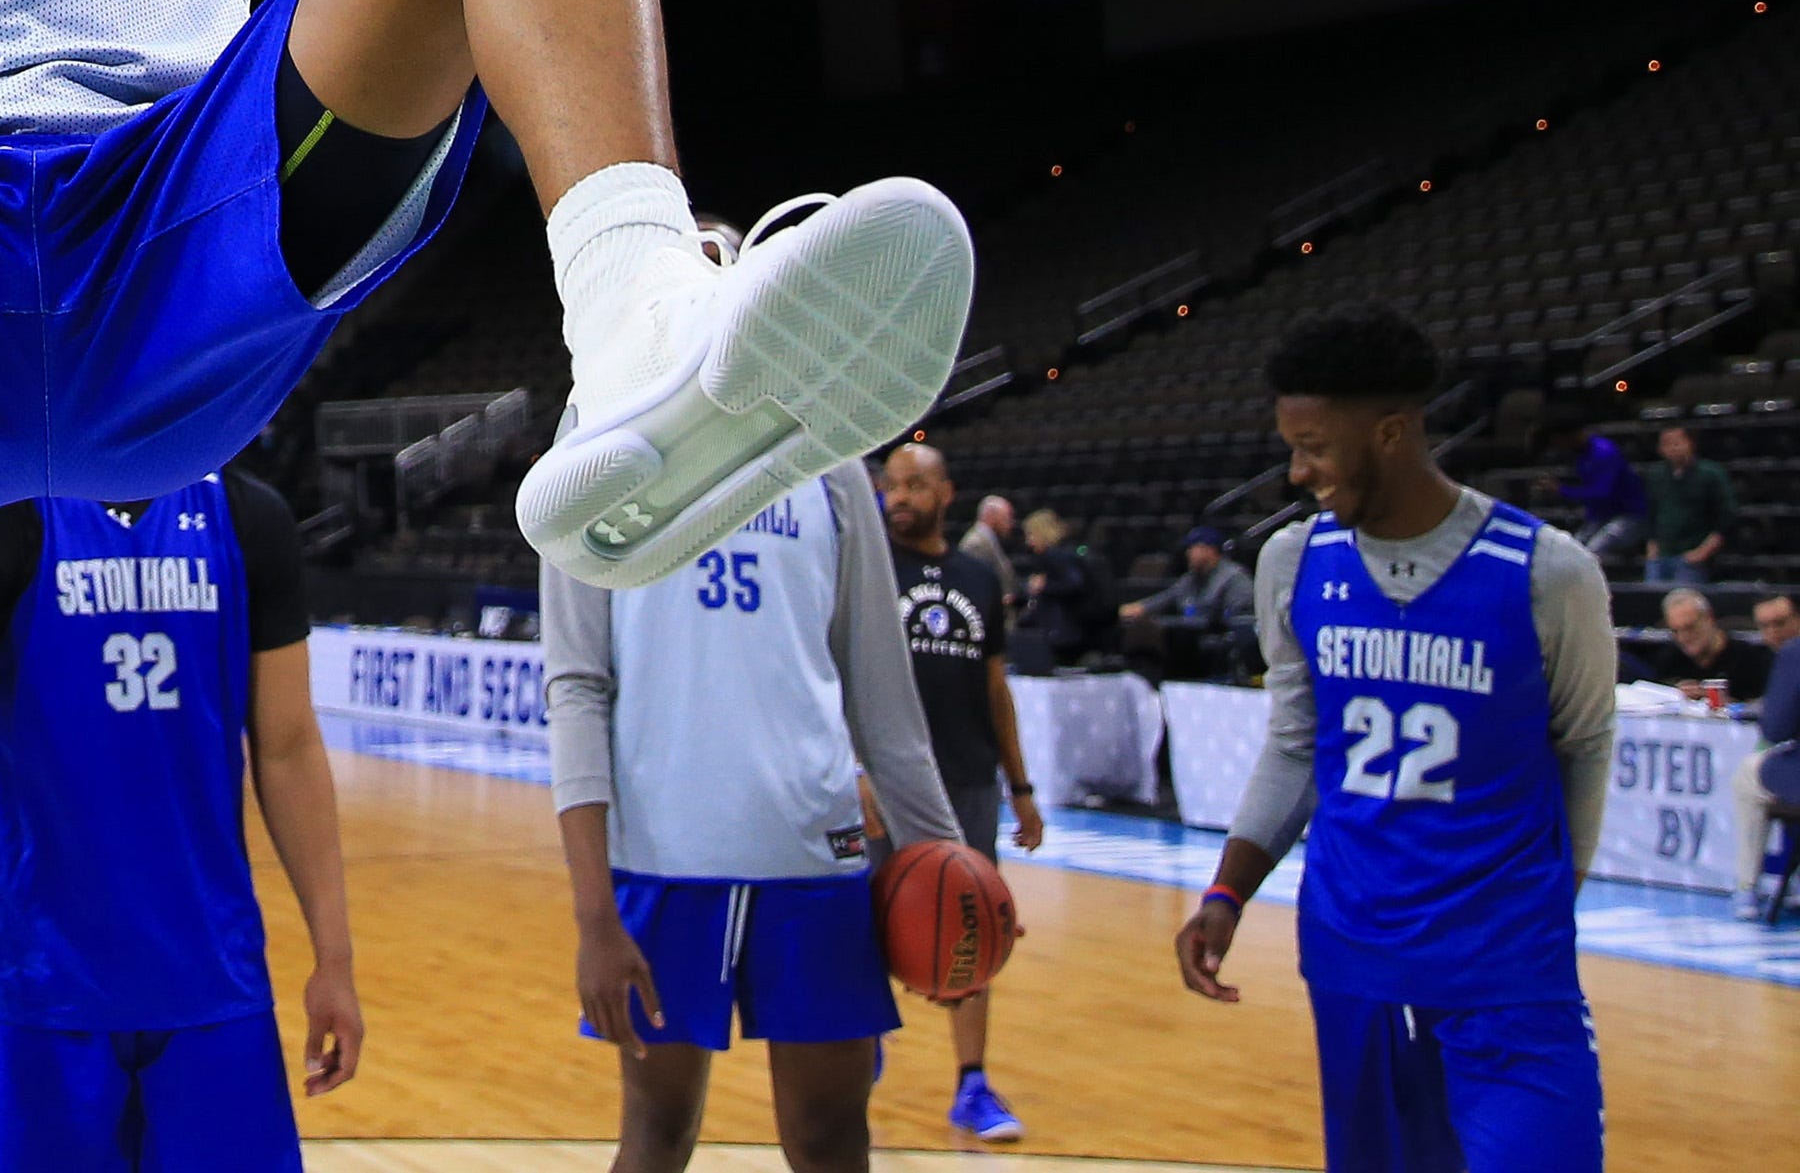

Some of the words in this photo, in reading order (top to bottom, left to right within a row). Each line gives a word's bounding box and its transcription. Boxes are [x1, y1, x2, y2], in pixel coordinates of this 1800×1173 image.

[56, 559, 139, 616] SETON
[139, 557, 219, 612] HALL
[697, 548, 761, 612] 35
[102, 631, 181, 712] 32
[351, 647, 416, 708] FIRST
[422, 652, 473, 716] AND
[1316, 624, 1406, 683] SETON
[1407, 631, 1493, 695] HALL
[1340, 695, 1460, 803] 22
[1618, 737, 1713, 796] STED
[1656, 804, 1705, 860] BY
[945, 891, 978, 989] Wilson
